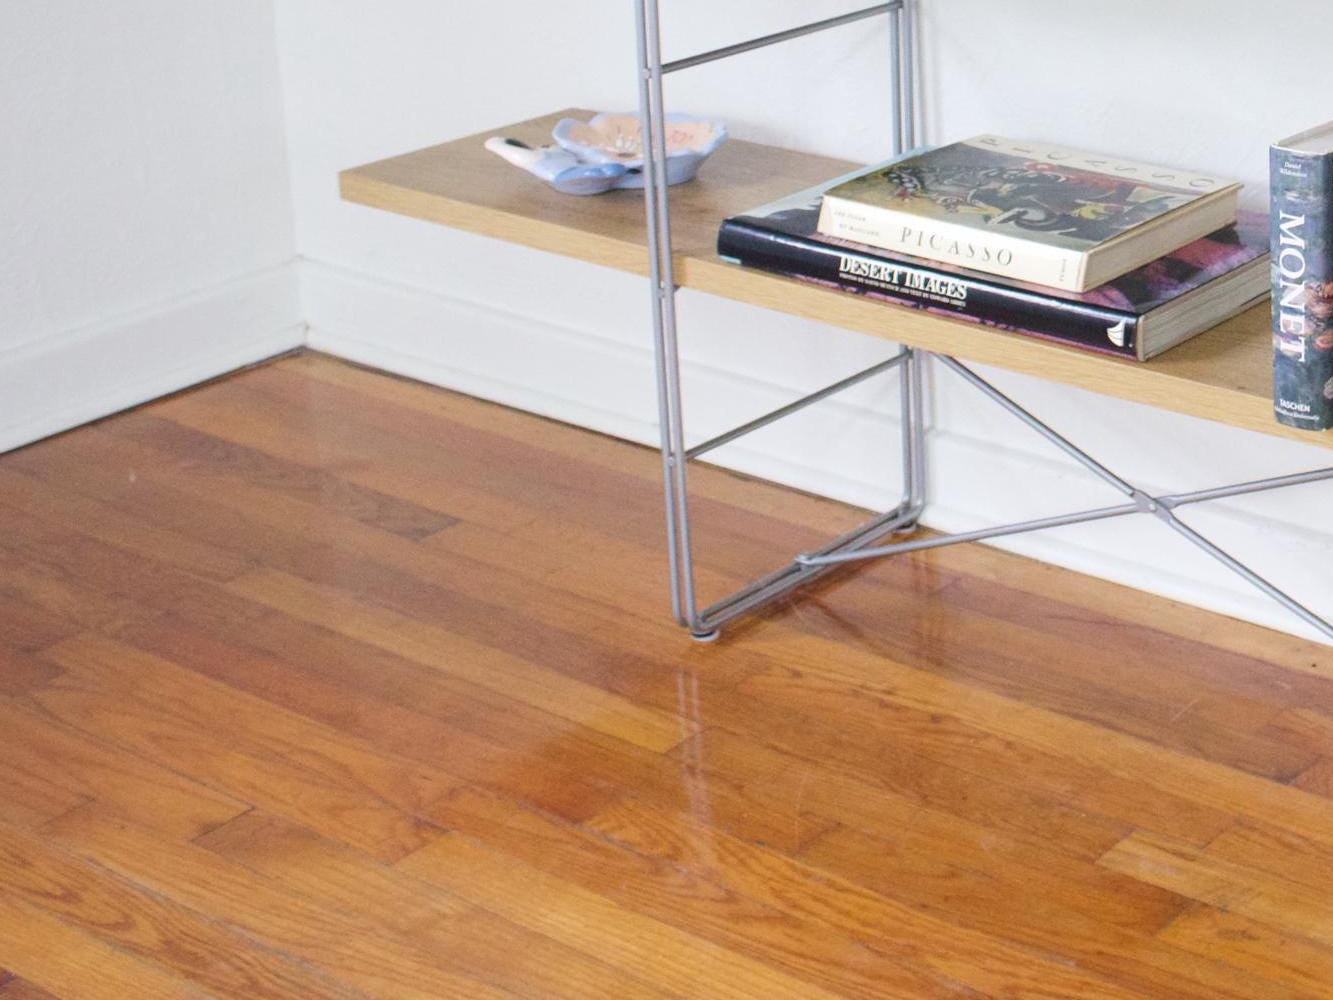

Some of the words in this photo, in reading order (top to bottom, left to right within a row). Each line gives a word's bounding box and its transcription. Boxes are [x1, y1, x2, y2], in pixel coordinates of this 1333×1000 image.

[980, 138, 1216, 188] PICASSO
[899, 226, 1013, 267] PICASSO
[839, 256, 901, 285] DESERT
[904, 270, 968, 300] IMAGES
[1279, 209, 1305, 362] MONET
[1280, 399, 1311, 412] TASCHEN
